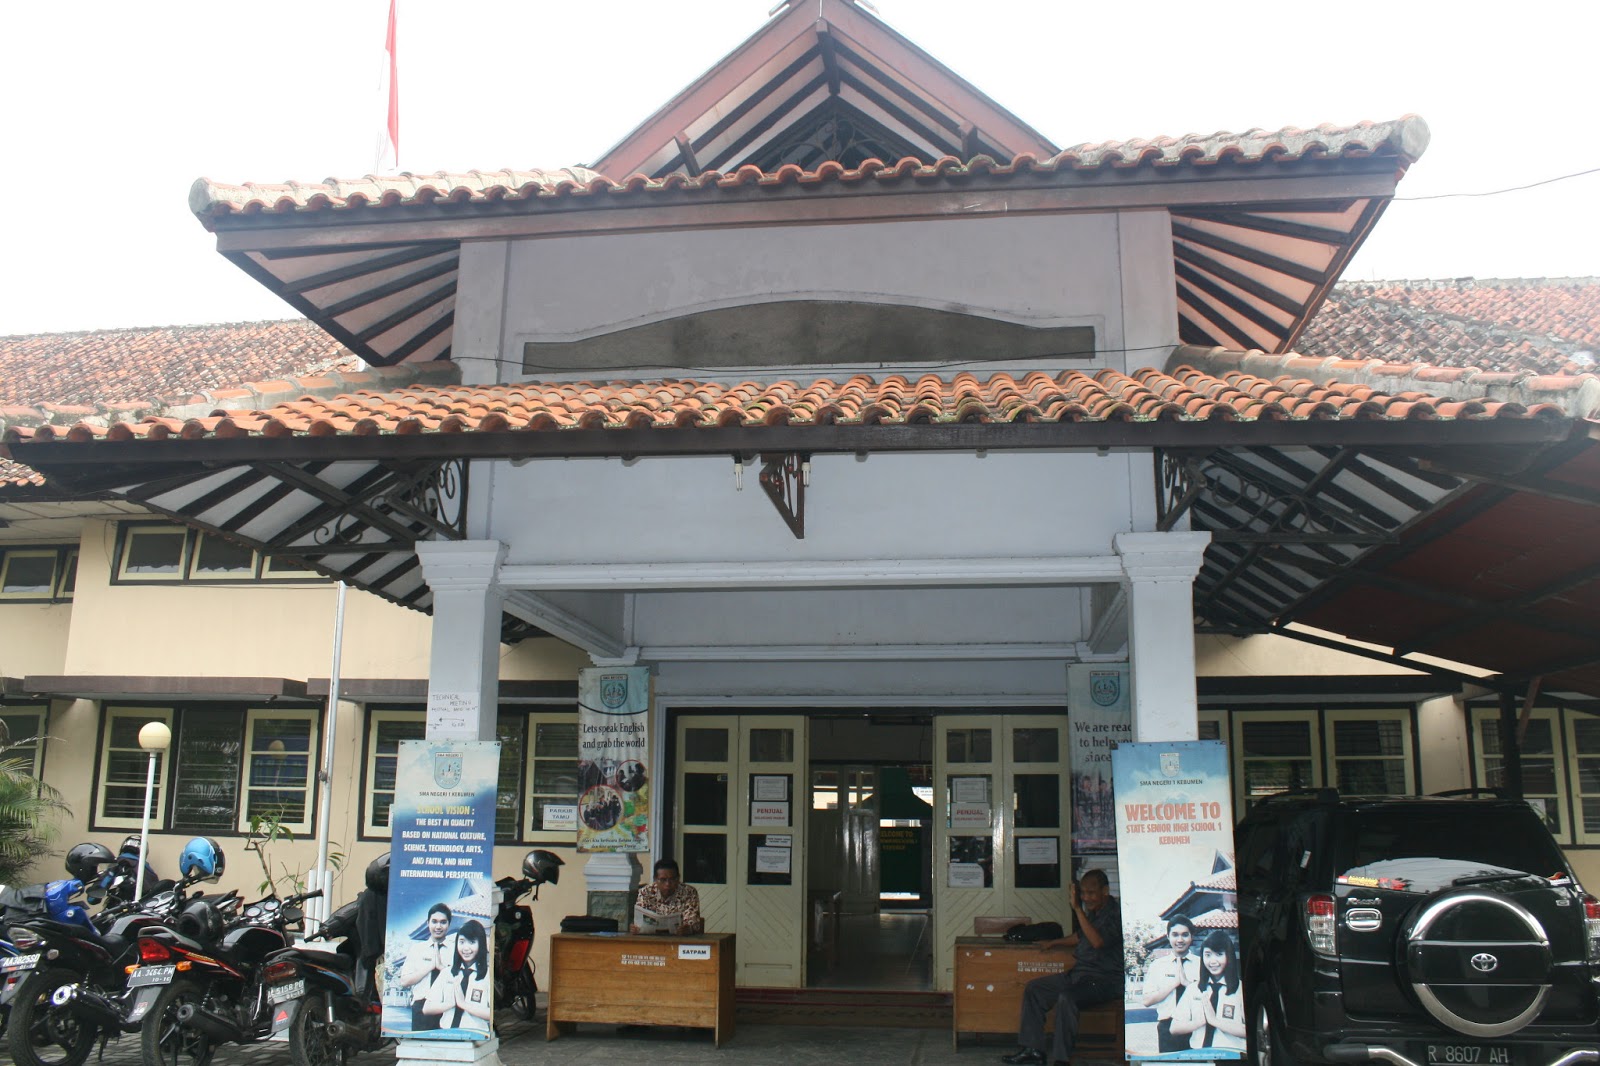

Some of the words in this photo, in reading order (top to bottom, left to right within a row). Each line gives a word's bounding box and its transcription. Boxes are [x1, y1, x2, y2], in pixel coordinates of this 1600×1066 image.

[583, 724, 597, 733] Lets
[599, 723, 618, 735] speak
[620, 723, 644, 735] English
[1074, 722, 1090, 732] We
[1093, 724, 1109, 732] are
[583, 738, 595, 748] and
[597, 738, 612, 751] grab
[614, 738, 624, 748] the
[626, 738, 645, 748] world
[1080, 738, 1089, 747] to
[1085, 752, 1111, 762] since
[417, 806, 443, 814] SCHOOL
[446, 806, 470, 815] VISION
[1125, 802, 1196, 821] WELCOME
[1200, 802, 1221, 819] TO
[1126, 824, 1145, 833] STATE
[1147, 823, 1171, 833] SENIOR
[1173, 823, 1189, 832] HIGH
[1191, 822, 1216, 832] SCHOOL
[1218, 822, 1222, 831] 1
[460, 832, 486, 841] CULTURE,
[1159, 836, 1190, 845] KEBUMEN
[404, 844, 427, 852] SCIENCE,
[429, 844, 464, 853] TECHNOLOGY,
[466, 846, 483, 854] ARTS,
[426, 857, 443, 866] FAITH,
[400, 870, 444, 878] INTERNATIONAL
[1428, 1046, 1437, 1061] R
[1445, 1046, 1481, 1062] 8607
[1489, 1048, 1509, 1063] AH
